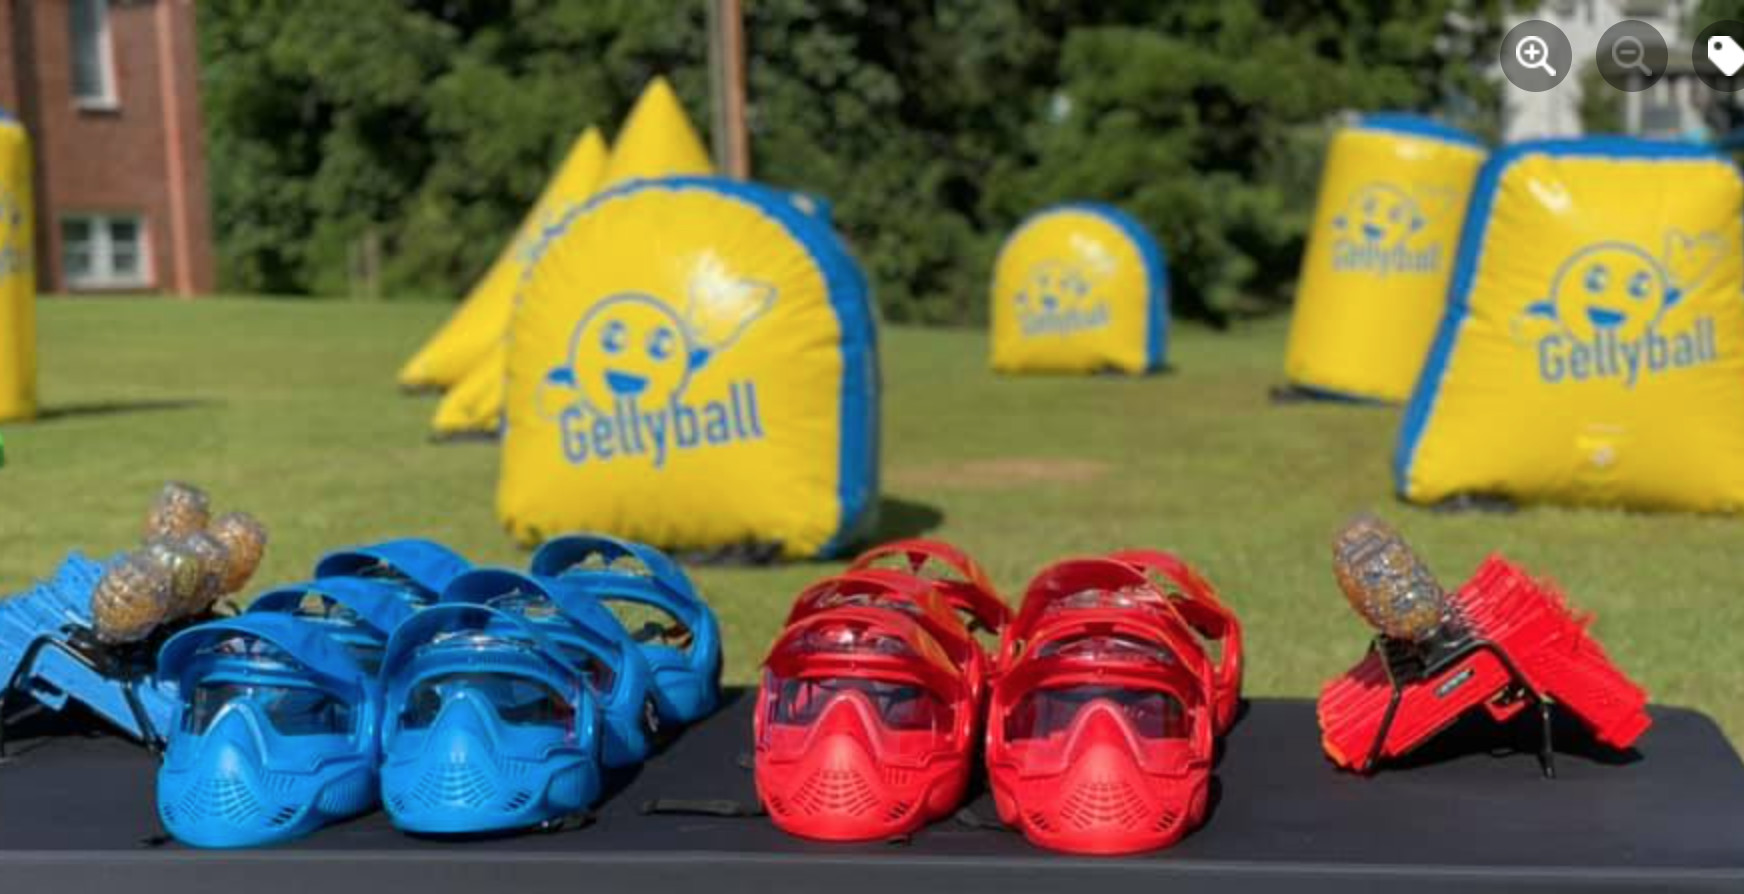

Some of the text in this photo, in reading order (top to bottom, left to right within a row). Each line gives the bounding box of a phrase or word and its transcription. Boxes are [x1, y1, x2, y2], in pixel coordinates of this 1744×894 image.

[1331, 240, 1443, 278] Gellyball
[1538, 317, 1717, 389] Gellyball
[560, 380, 765, 469] Gellyball
